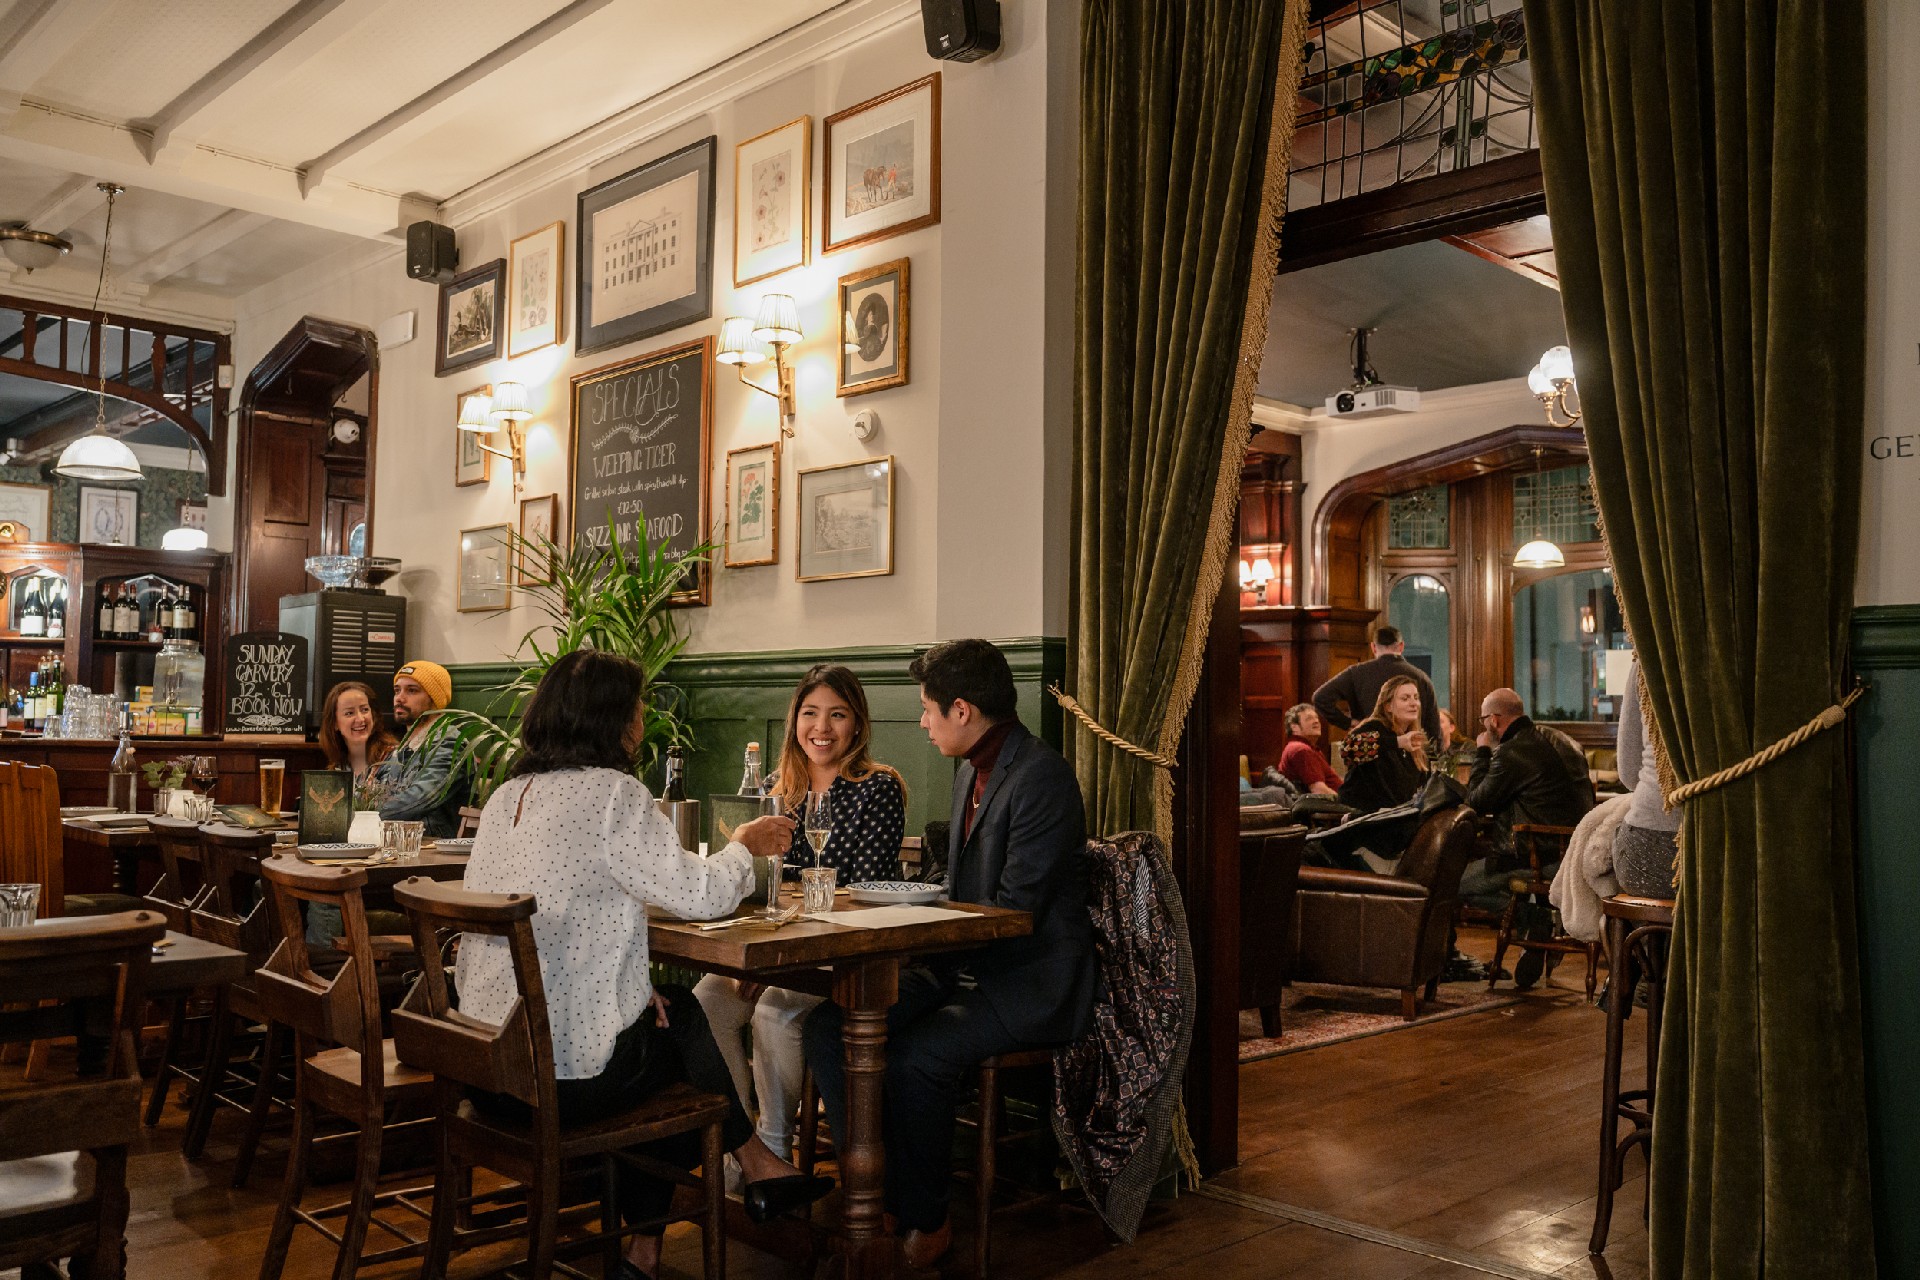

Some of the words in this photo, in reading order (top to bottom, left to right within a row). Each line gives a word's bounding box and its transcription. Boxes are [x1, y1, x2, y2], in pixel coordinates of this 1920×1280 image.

[592, 363, 680, 426] SPECIALS
[1870, 434, 1920, 460] GE
[593, 449, 643, 479] WEEPING
[645, 442, 677, 469] TIGER
[585, 523, 631, 548] SIZZING
[237, 644, 296, 666] SUNDAY
[235, 664, 295, 683] CARVERY
[229, 696, 270, 715] BOOK
[274, 697, 303, 716] NOW
